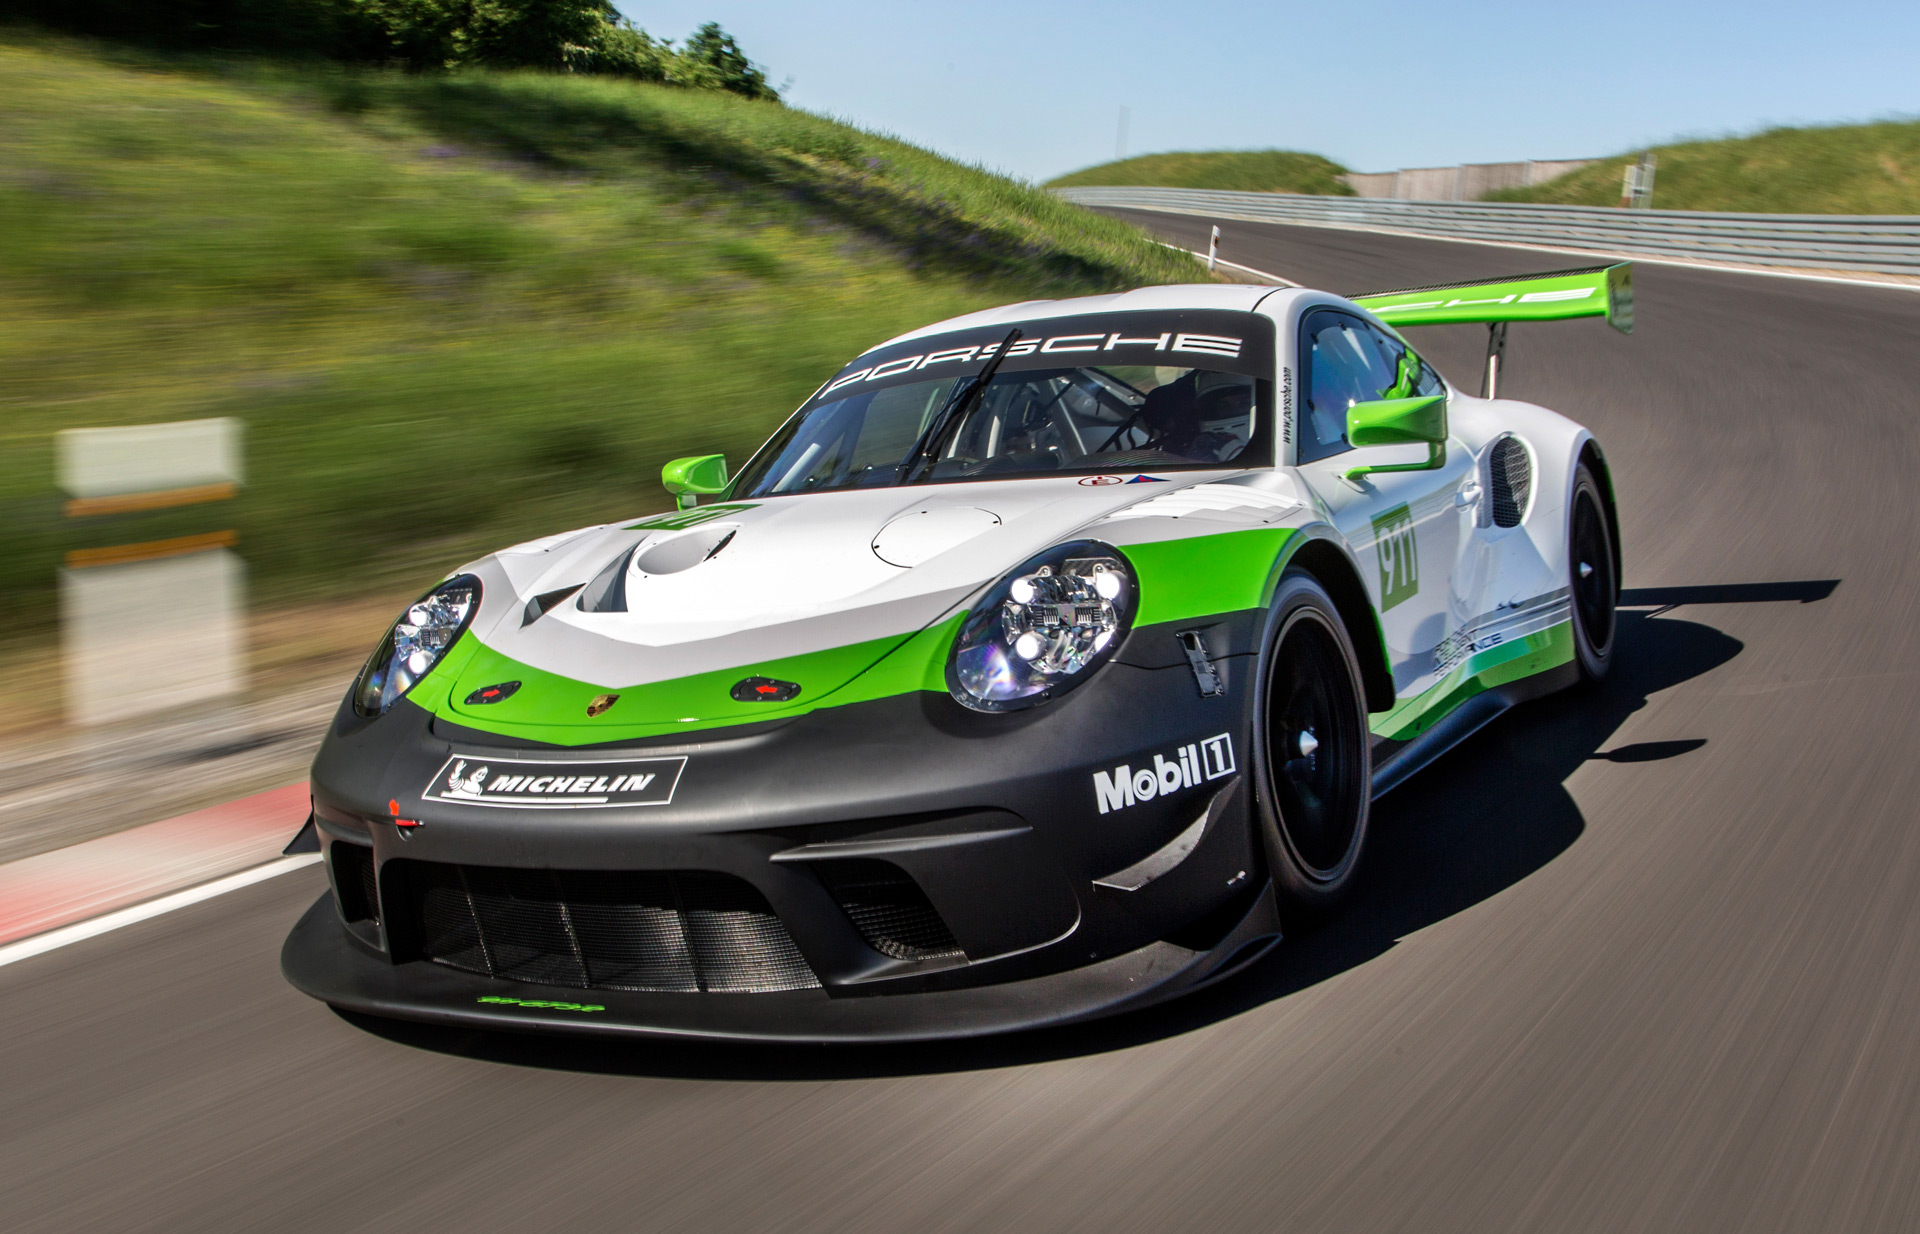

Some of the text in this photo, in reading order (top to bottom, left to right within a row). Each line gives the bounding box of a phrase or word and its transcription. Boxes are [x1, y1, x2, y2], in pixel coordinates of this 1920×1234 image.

[818, 332, 1243, 400] PORSCHE
[1378, 517, 1417, 596] 911
[487, 773, 656, 793] MICHELIN
[1093, 743, 1202, 815] Mobil
